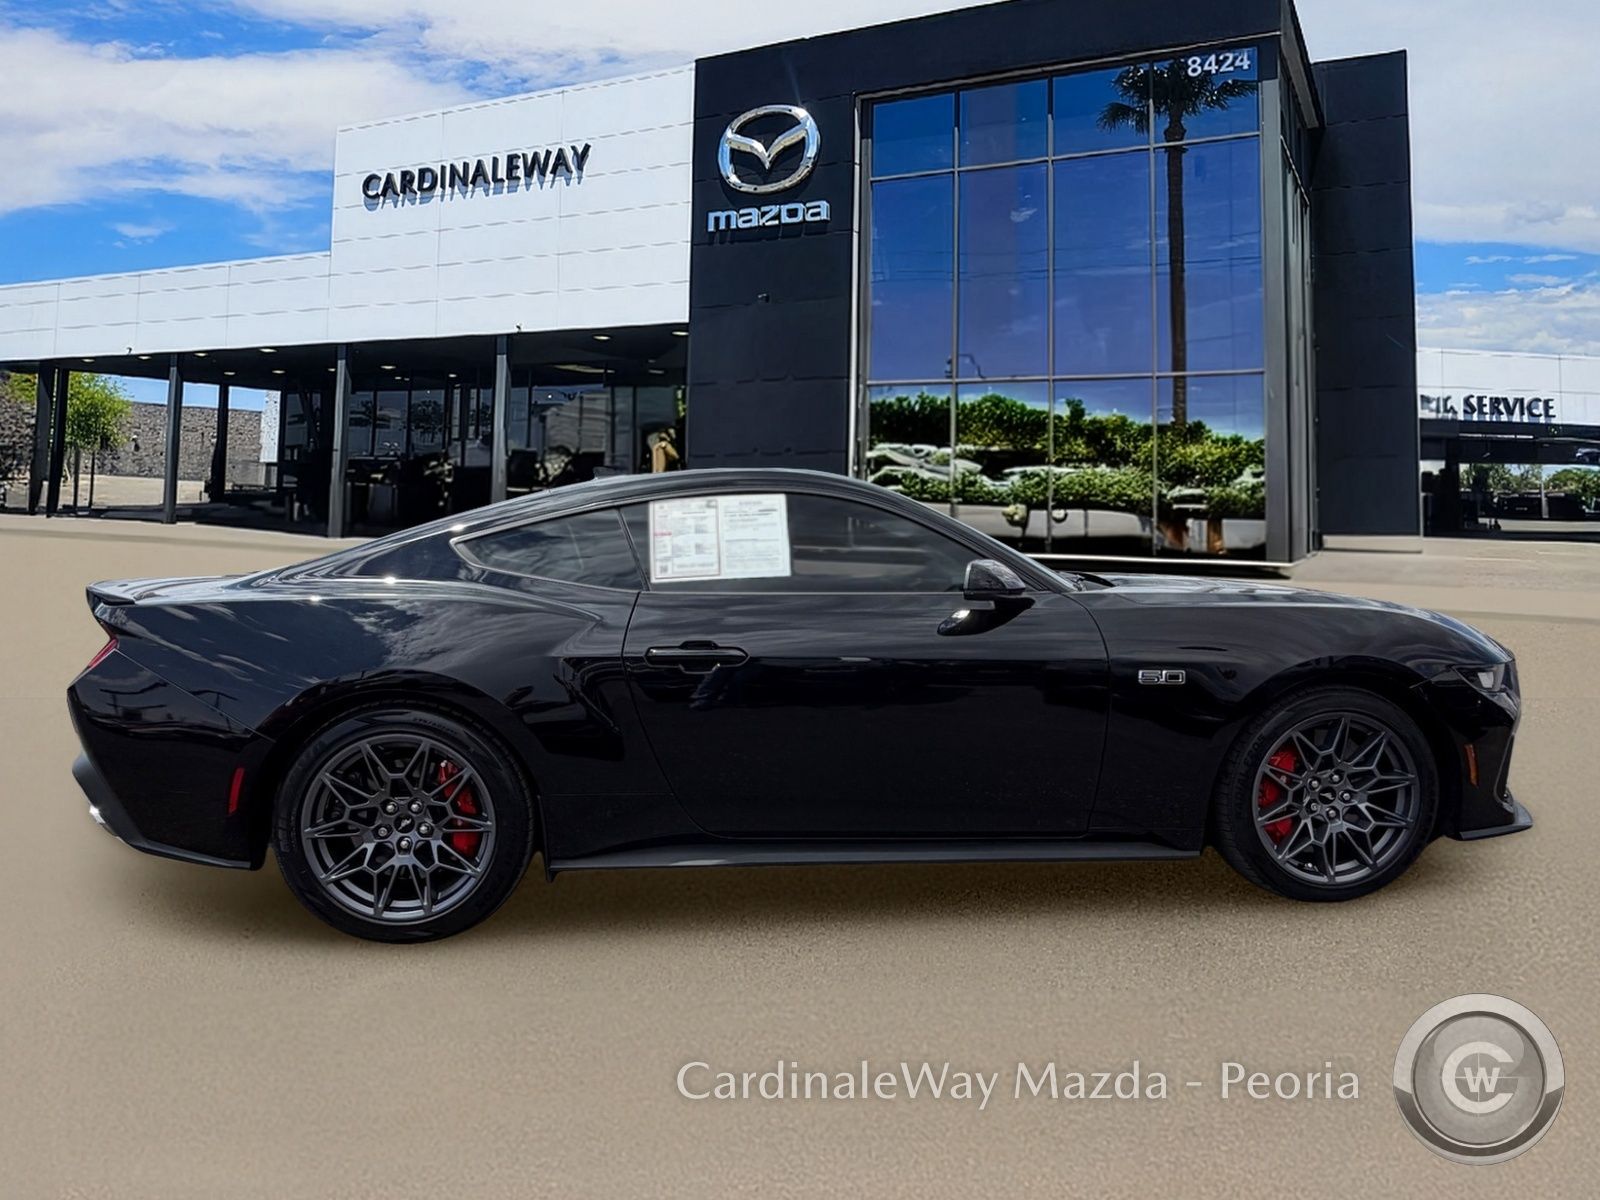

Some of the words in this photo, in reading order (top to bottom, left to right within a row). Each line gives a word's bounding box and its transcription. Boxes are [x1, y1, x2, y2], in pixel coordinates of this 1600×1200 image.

[1187, 51, 1251, 77] 8424
[361, 143, 592, 200] CARDINALEWAY
[707, 200, 830, 232] mazda
[1463, 394, 1557, 419] SERVICE
